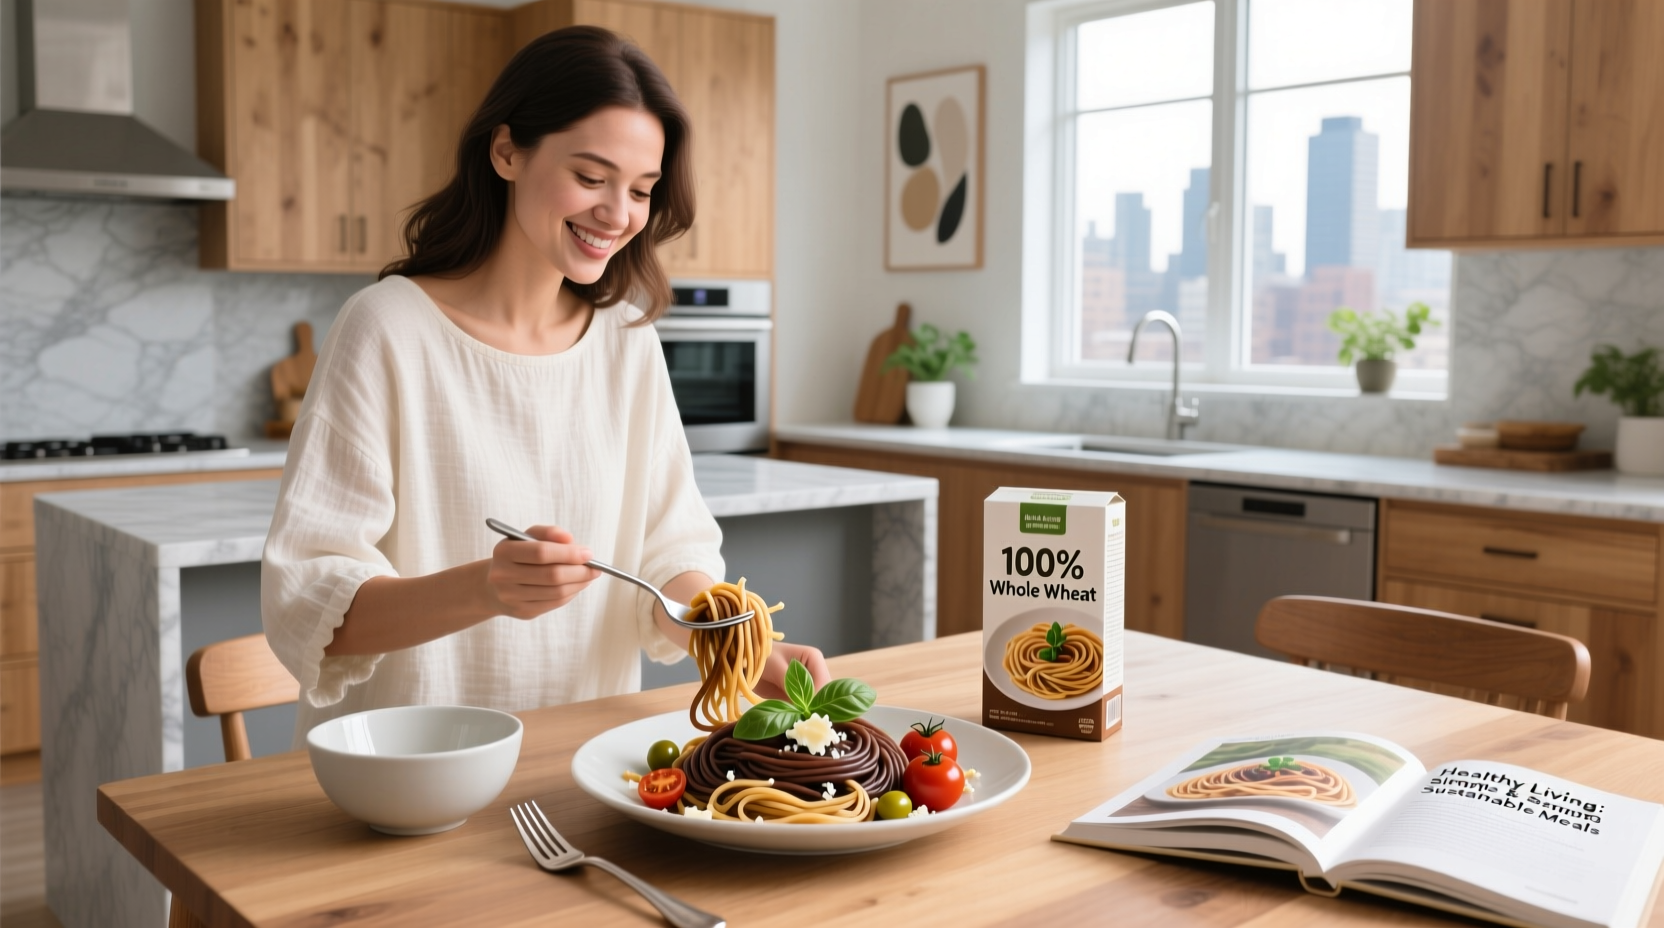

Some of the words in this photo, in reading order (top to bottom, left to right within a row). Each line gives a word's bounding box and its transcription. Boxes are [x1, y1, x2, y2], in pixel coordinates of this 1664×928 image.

[1001, 546, 1084, 580] 100%
[989, 579, 1040, 598] Whole
[1043, 583, 1097, 602] Wheat
[1439, 766, 1525, 791] Healthy
[1529, 782, 1605, 813] Living:
[1538, 810, 1600, 835] Meals
